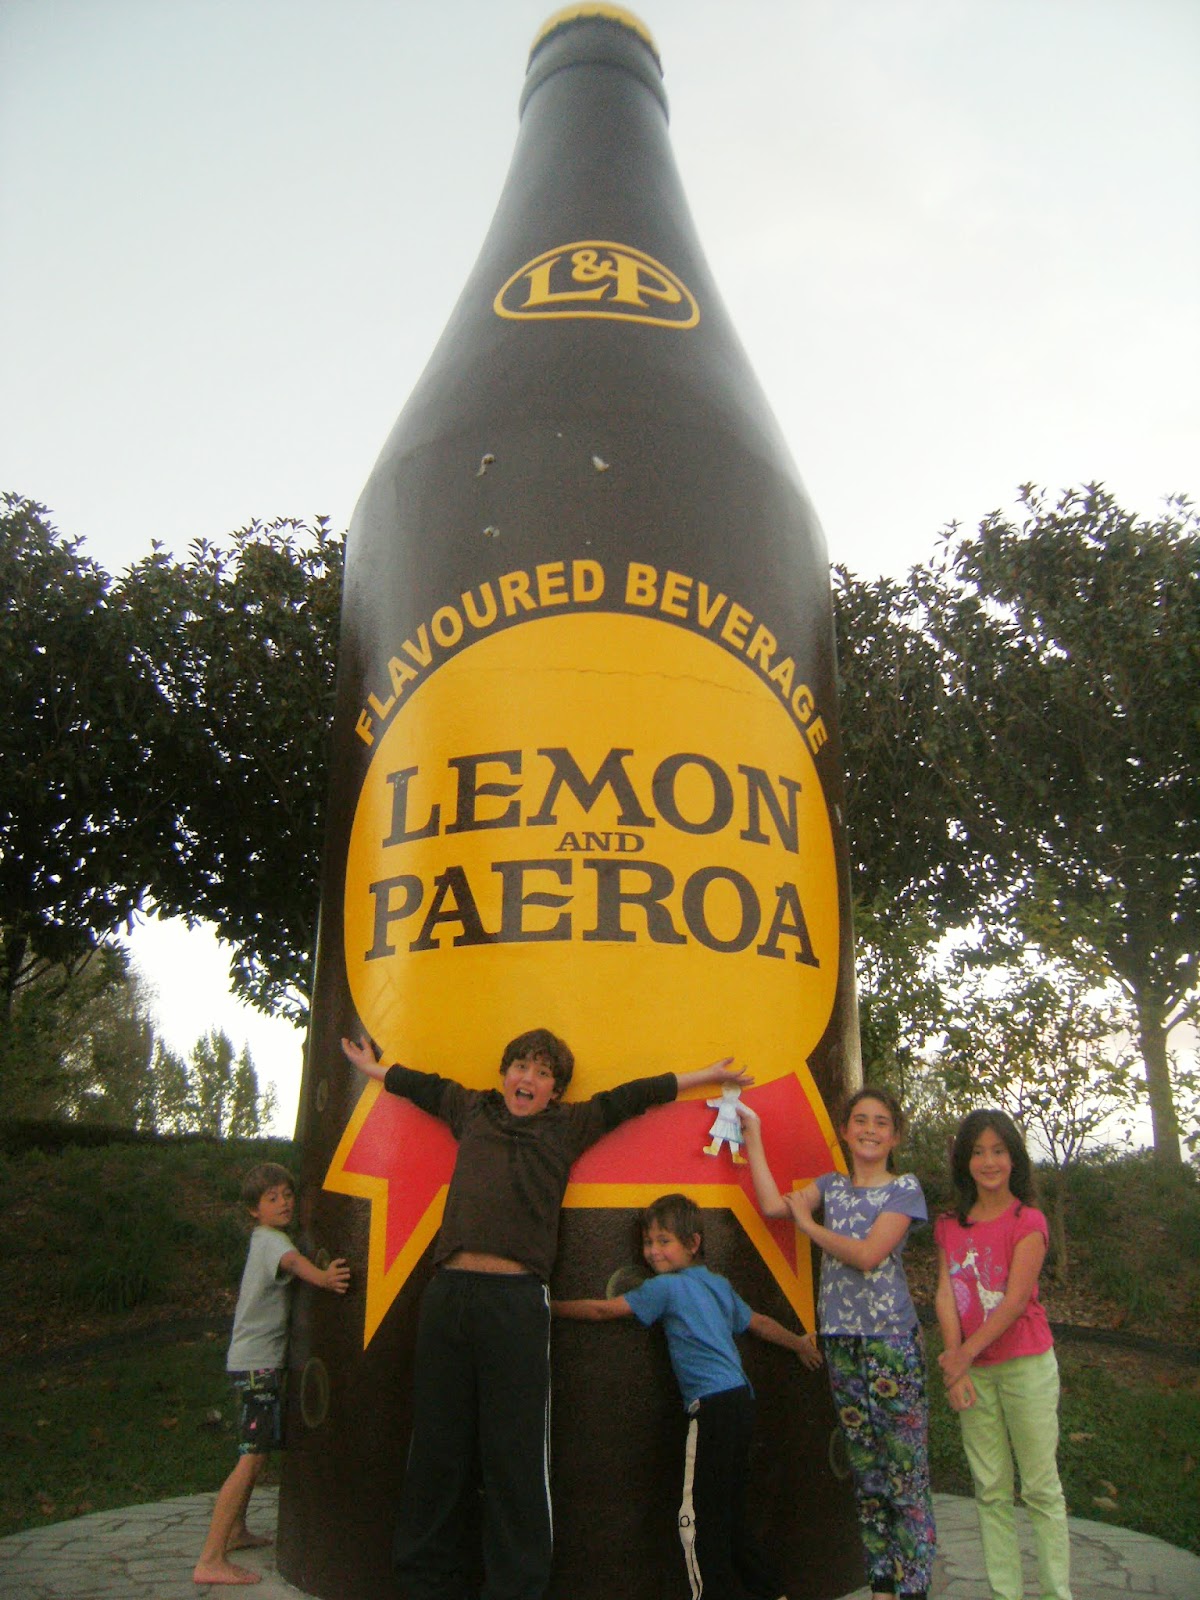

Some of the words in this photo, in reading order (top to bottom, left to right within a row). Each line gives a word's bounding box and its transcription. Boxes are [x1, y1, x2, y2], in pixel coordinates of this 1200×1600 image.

[520, 249, 682, 308] L&P
[355, 559, 606, 747] FLAVOURED
[624, 561, 829, 755] BEVERAGE
[382, 747, 802, 855] LEMON
[554, 831, 645, 853] AND
[364, 858, 821, 969] PAEROA
